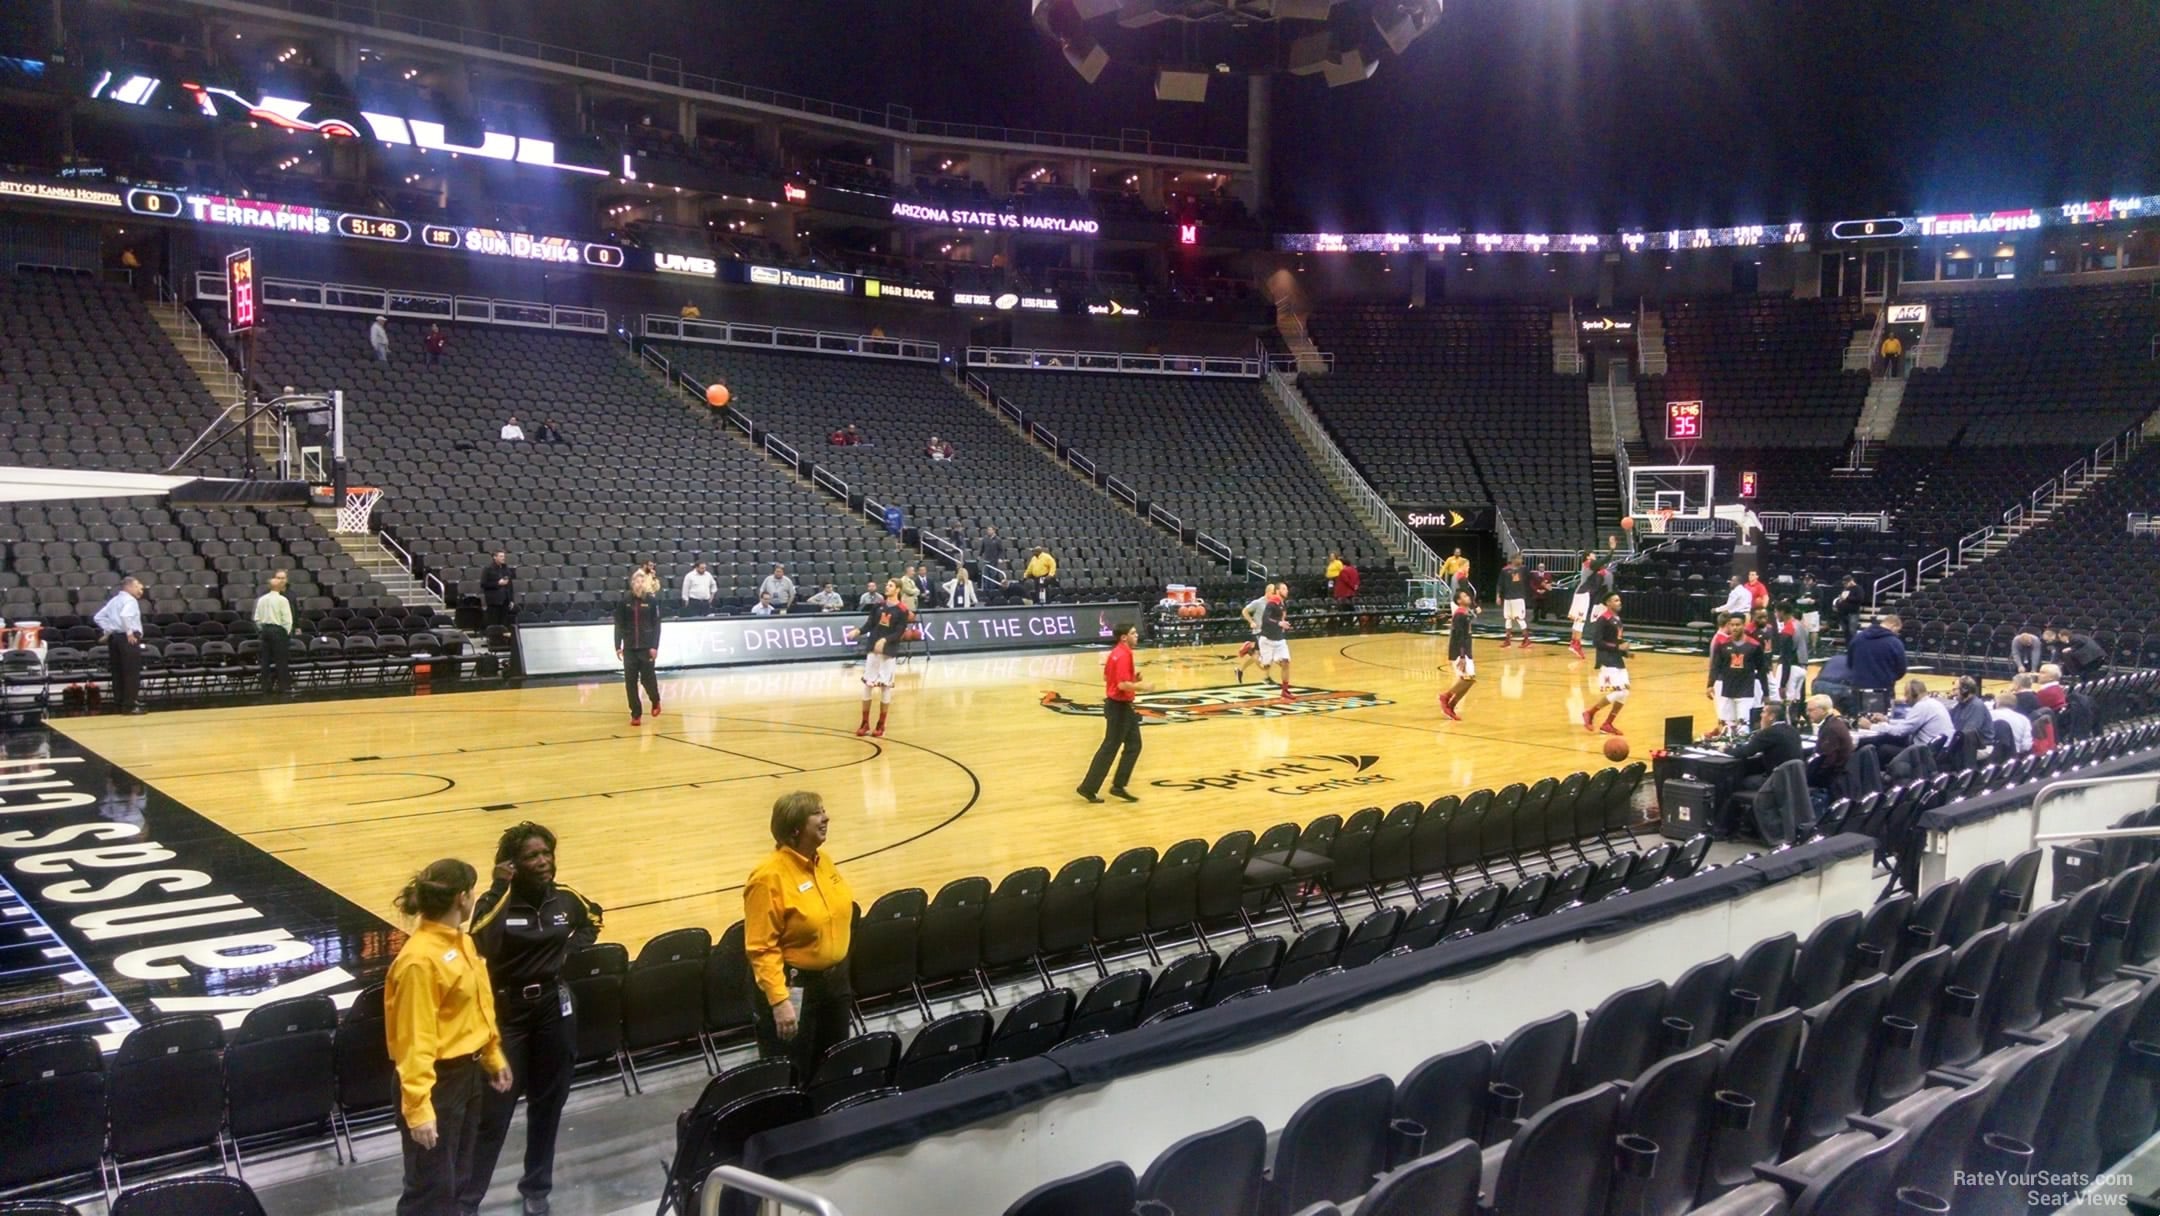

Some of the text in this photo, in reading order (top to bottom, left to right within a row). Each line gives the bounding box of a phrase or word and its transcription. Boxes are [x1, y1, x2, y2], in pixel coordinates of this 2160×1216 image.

[23, 184, 37, 194] OF
[38, 185, 76, 198] KANSAS
[77, 189, 120, 203] HOSPITAL
[148, 195, 160, 211] 0
[2109, 197, 2141, 212] Fouls
[187, 197, 330, 233] TERRAPINS
[892, 203, 1098, 233] ARIZONA STATE VS. MARYLAND
[352, 219, 396, 238] 51:46
[1181, 225, 1196, 244] M
[1865, 222, 1874, 234] 0
[1918, 215, 2041, 236] TERRAPINS
[433, 230, 450, 243] 1ST
[1423, 233, 1461, 244] Rebounds
[466, 231, 578, 263] SUN DEVILS
[599, 249, 609, 262] 0
[654, 252, 716, 274] UMB
[782, 271, 845, 292] Farmland
[881, 284, 935, 300] H&R BLOCK
[1088, 304, 1109, 315] Sprint
[1582, 320, 1604, 330] Sprint
[1675, 416, 1696, 435] 35
[1408, 513, 1446, 528] Sprint
[944, 620, 968, 641] AT
[978, 618, 1021, 638] THE
[1028, 615, 1076, 635] CBE!
[1730, 654, 1744, 668] M
[1151, 762, 1332, 792] Sprint
[1267, 774, 1395, 796] Center
[0, 822, 364, 1053] Kansas
